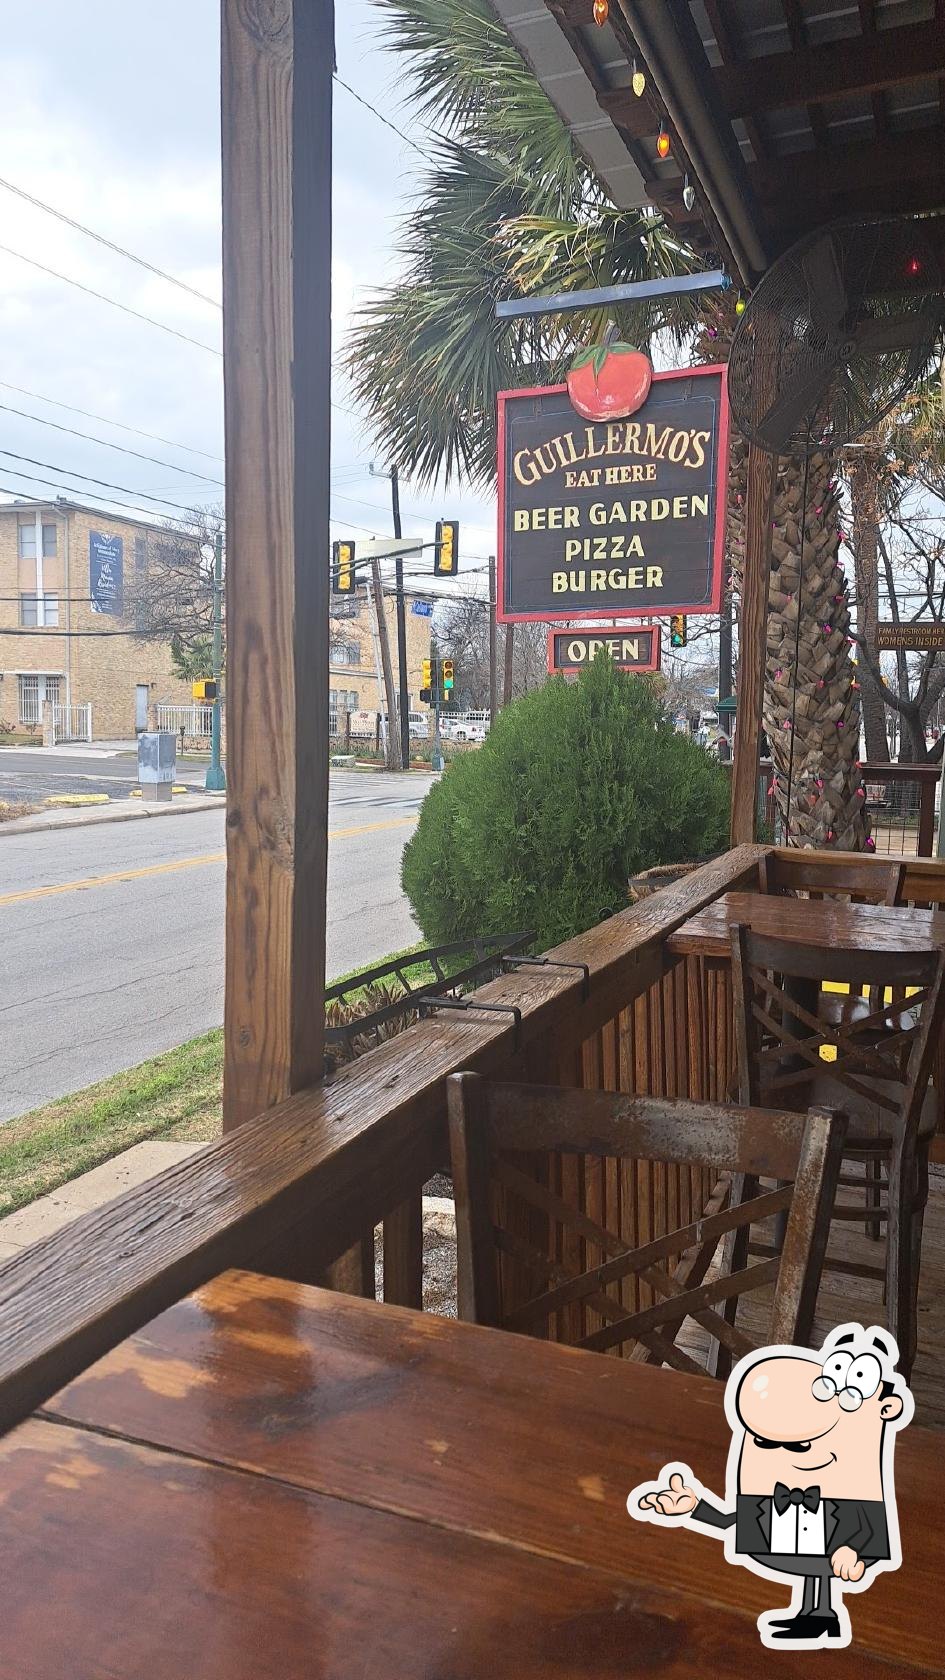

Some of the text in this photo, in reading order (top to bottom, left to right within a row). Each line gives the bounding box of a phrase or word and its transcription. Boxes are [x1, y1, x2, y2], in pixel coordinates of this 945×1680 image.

[513, 422, 711, 486] GUILLERMO'S
[564, 463, 657, 488] EAT HERE
[514, 494, 709, 532] BEER GARDEN
[565, 534, 645, 562] PIZZA
[552, 565, 664, 593] BURGER
[877, 636, 944, 646] WOMENS INSIDE
